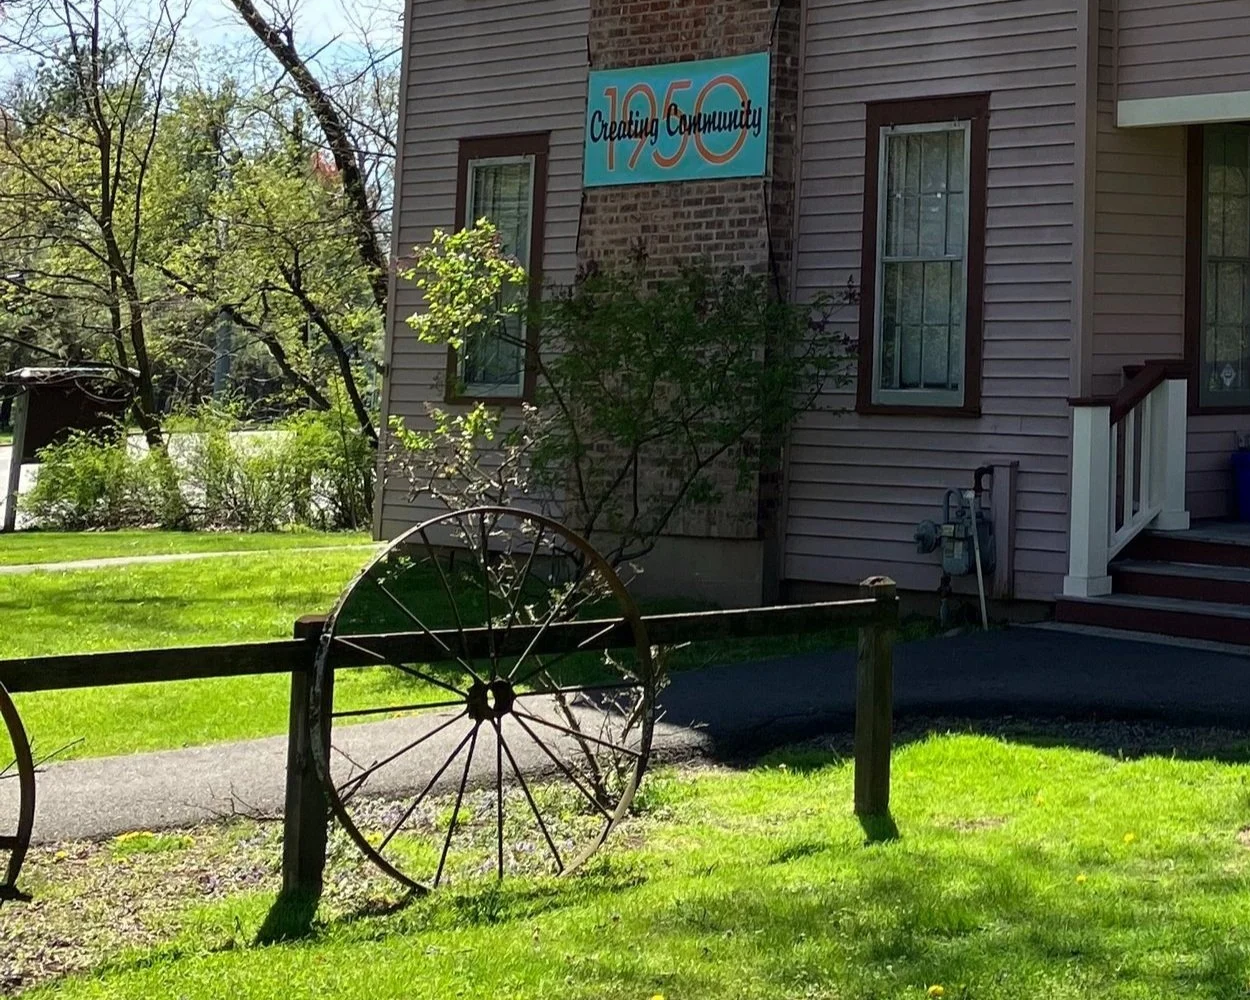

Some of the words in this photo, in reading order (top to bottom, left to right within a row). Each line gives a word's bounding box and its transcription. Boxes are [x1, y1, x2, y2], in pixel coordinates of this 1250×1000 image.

[590, 109, 659, 146] Creating
[666, 99, 762, 138] Community
[604, 73, 750, 172] 1950
